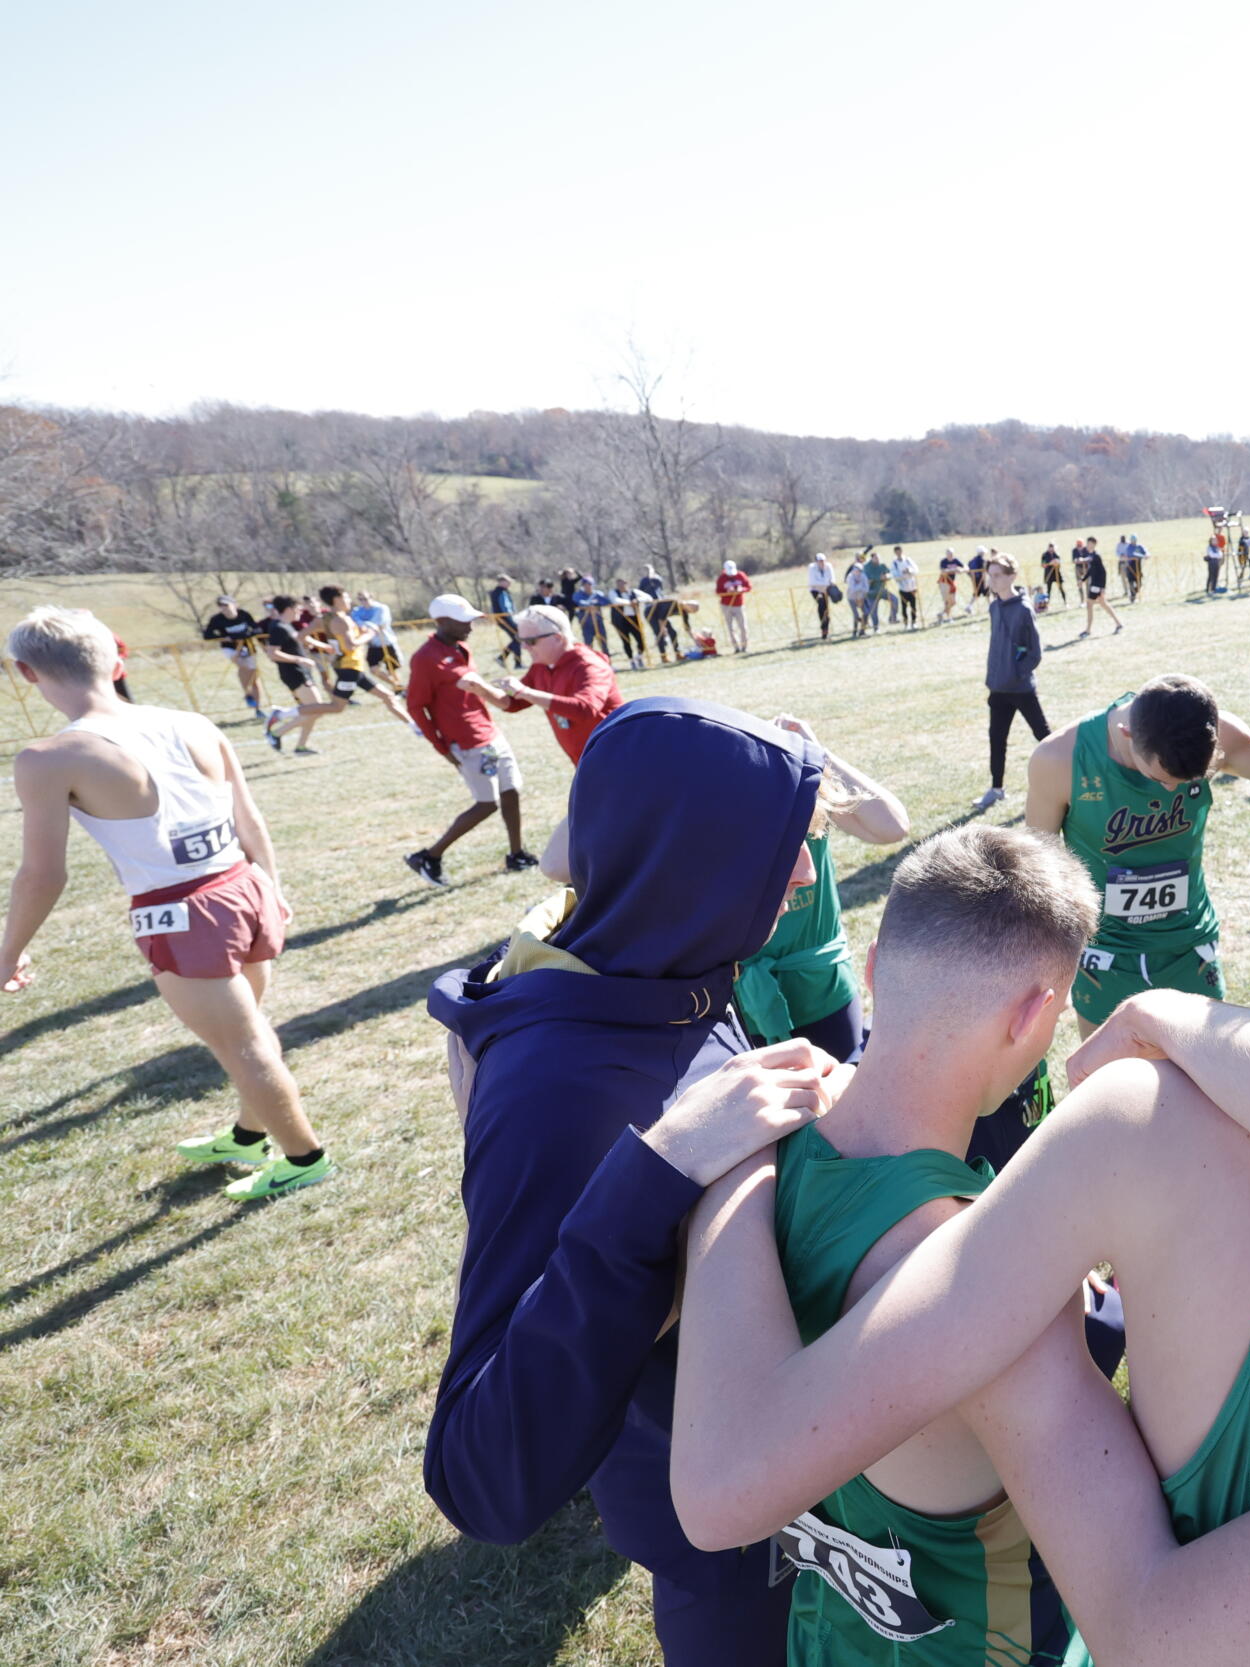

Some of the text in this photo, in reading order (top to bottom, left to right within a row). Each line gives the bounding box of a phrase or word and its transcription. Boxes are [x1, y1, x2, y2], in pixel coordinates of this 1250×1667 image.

[184, 821, 233, 860] 514
[1102, 793, 1191, 853] Irish
[1120, 883, 1177, 912] 746
[781, 1525, 902, 1627] 743
[832, 1537, 910, 1588] CHAMPIONSHIPS
